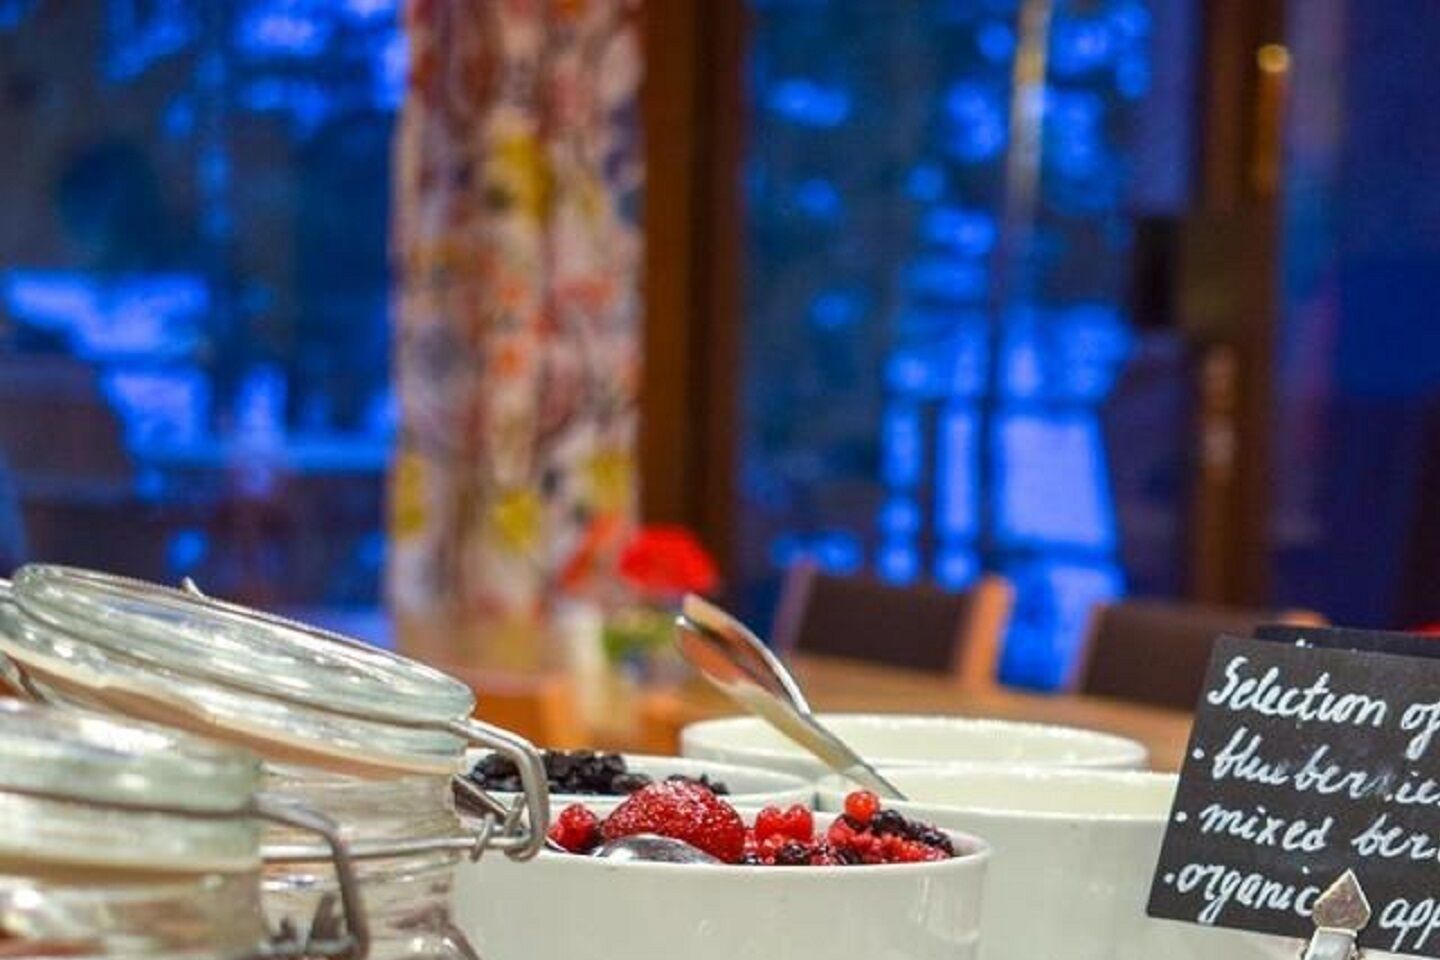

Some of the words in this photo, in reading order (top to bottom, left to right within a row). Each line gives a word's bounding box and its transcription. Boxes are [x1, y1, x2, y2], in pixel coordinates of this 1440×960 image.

[1208, 657, 1386, 727] Selection
[1200, 803, 1333, 852] mixed
[1177, 863, 1317, 924] organic
